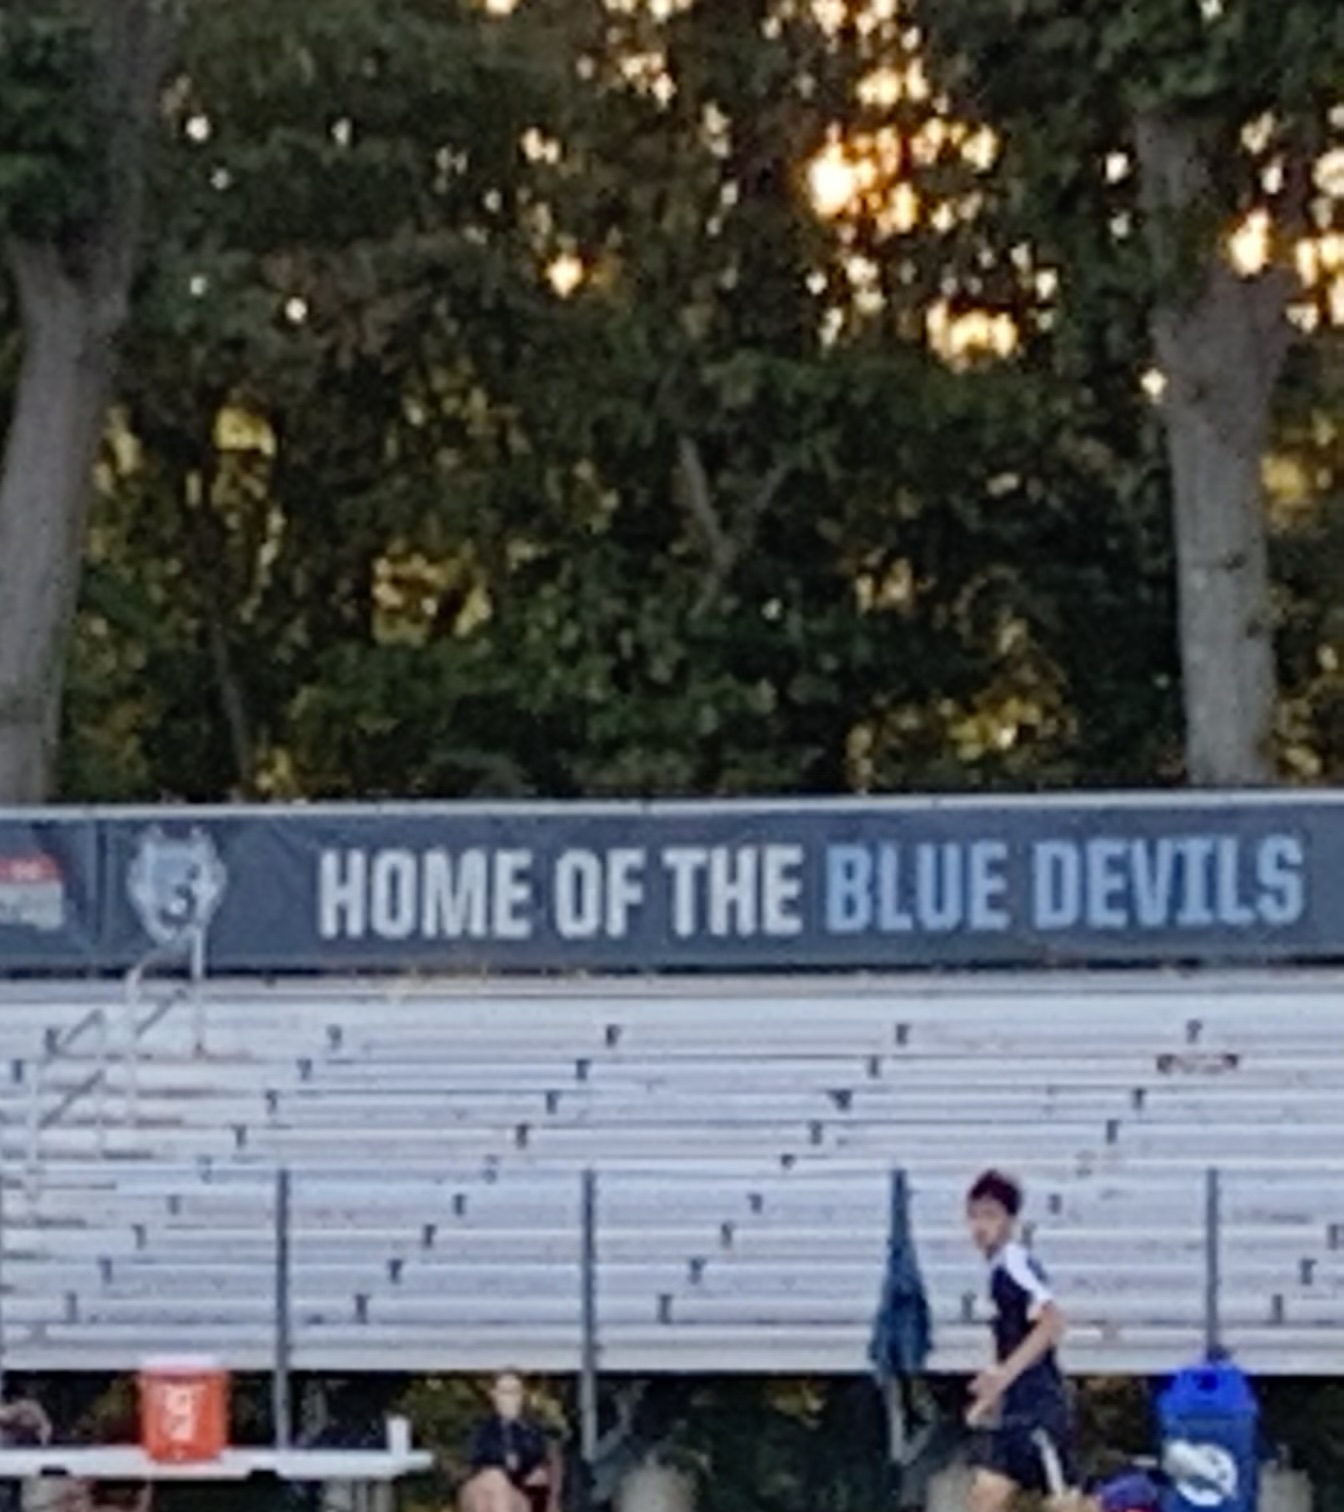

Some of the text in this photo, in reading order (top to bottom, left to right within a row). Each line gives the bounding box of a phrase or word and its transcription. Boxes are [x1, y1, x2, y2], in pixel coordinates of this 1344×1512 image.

[320, 836, 1304, 940] HOME OF THE BLUE DEVILS
